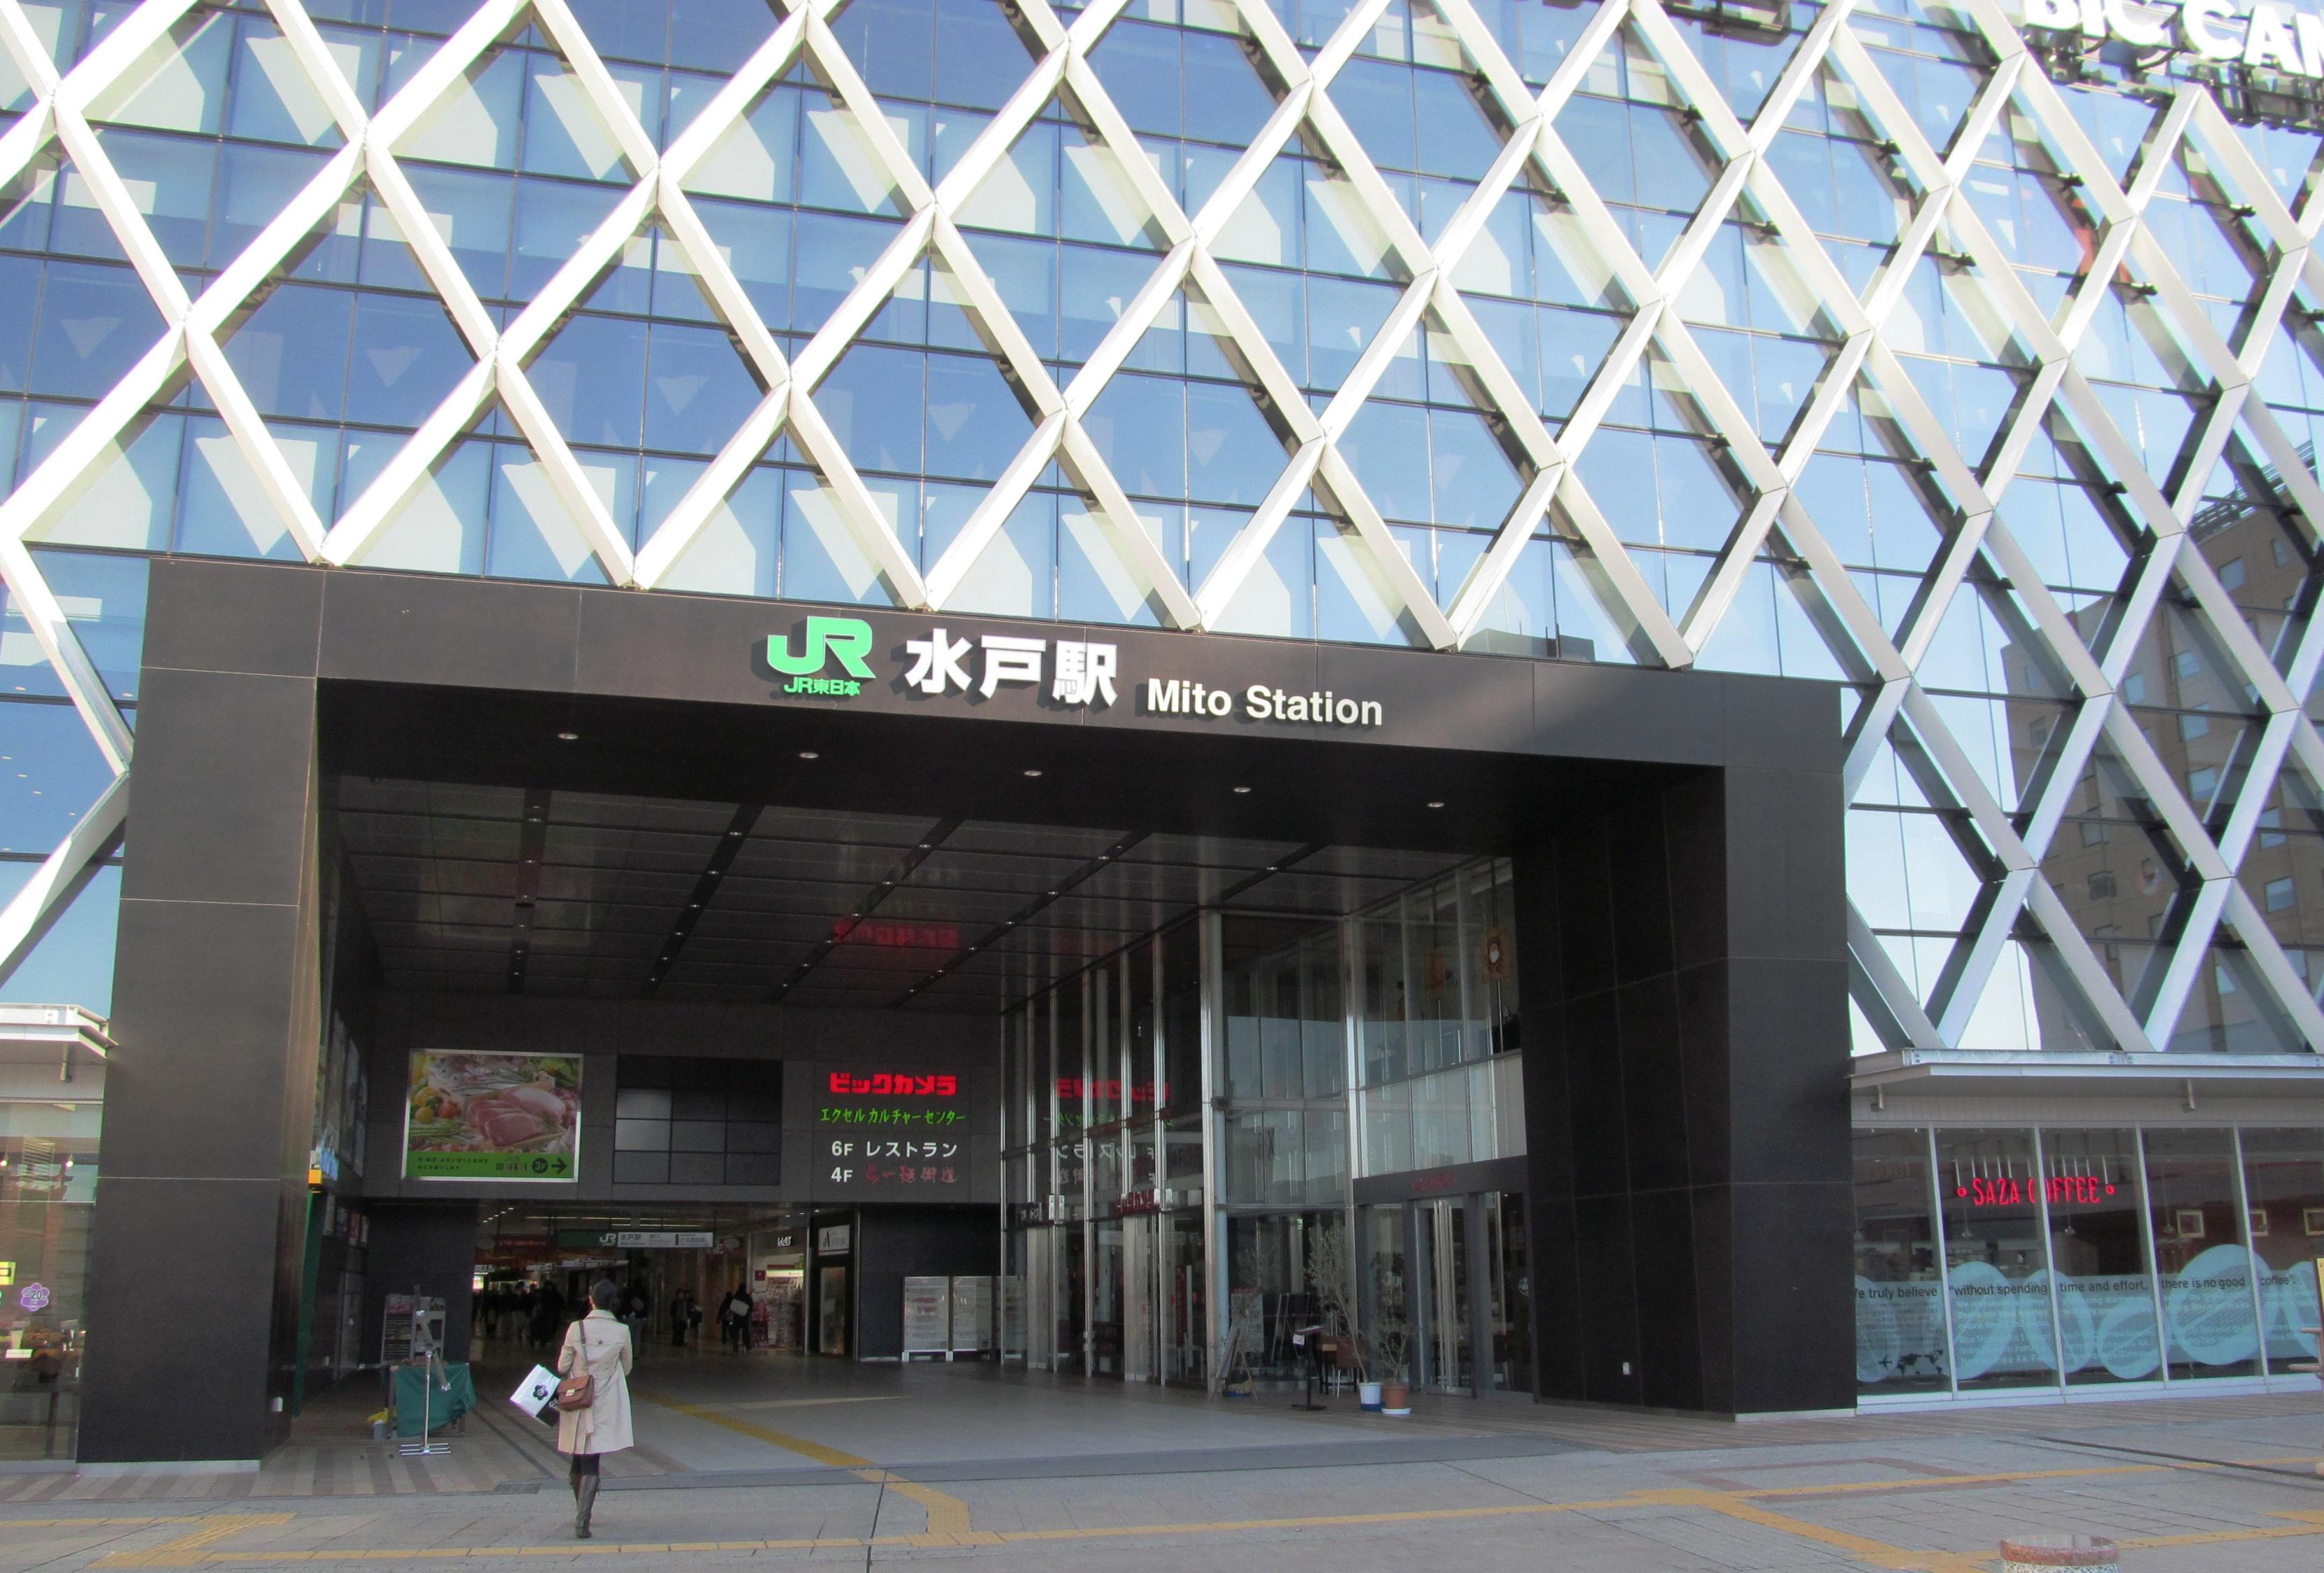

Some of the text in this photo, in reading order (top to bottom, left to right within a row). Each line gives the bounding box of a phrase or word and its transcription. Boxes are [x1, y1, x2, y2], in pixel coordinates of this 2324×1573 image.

[767, 616, 876, 679] JR
[904, 628, 1118, 707] 水戸駅
[784, 676, 861, 697] JR東日本
[1147, 677, 1383, 727] Mito Station
[829, 1073, 957, 1096] ビックカメラ
[831, 1140, 957, 1158] 6F レストラン
[831, 1166, 853, 1182] 4F
[1972, 1177, 2021, 1205] SAZA
[600, 1233, 616, 1242] JR
[1868, 1287, 1894, 1300] truly
[1898, 1286, 1938, 1298] believe
[1998, 1283, 2048, 1296] spending
[2059, 1282, 2084, 1292] time
[2089, 1280, 2109, 1291] and
[2161, 1278, 2188, 1289] there
[2191, 1277, 2201, 1287] is
[2204, 1278, 2216, 1288] no
[2218, 1276, 2246, 1289] good
